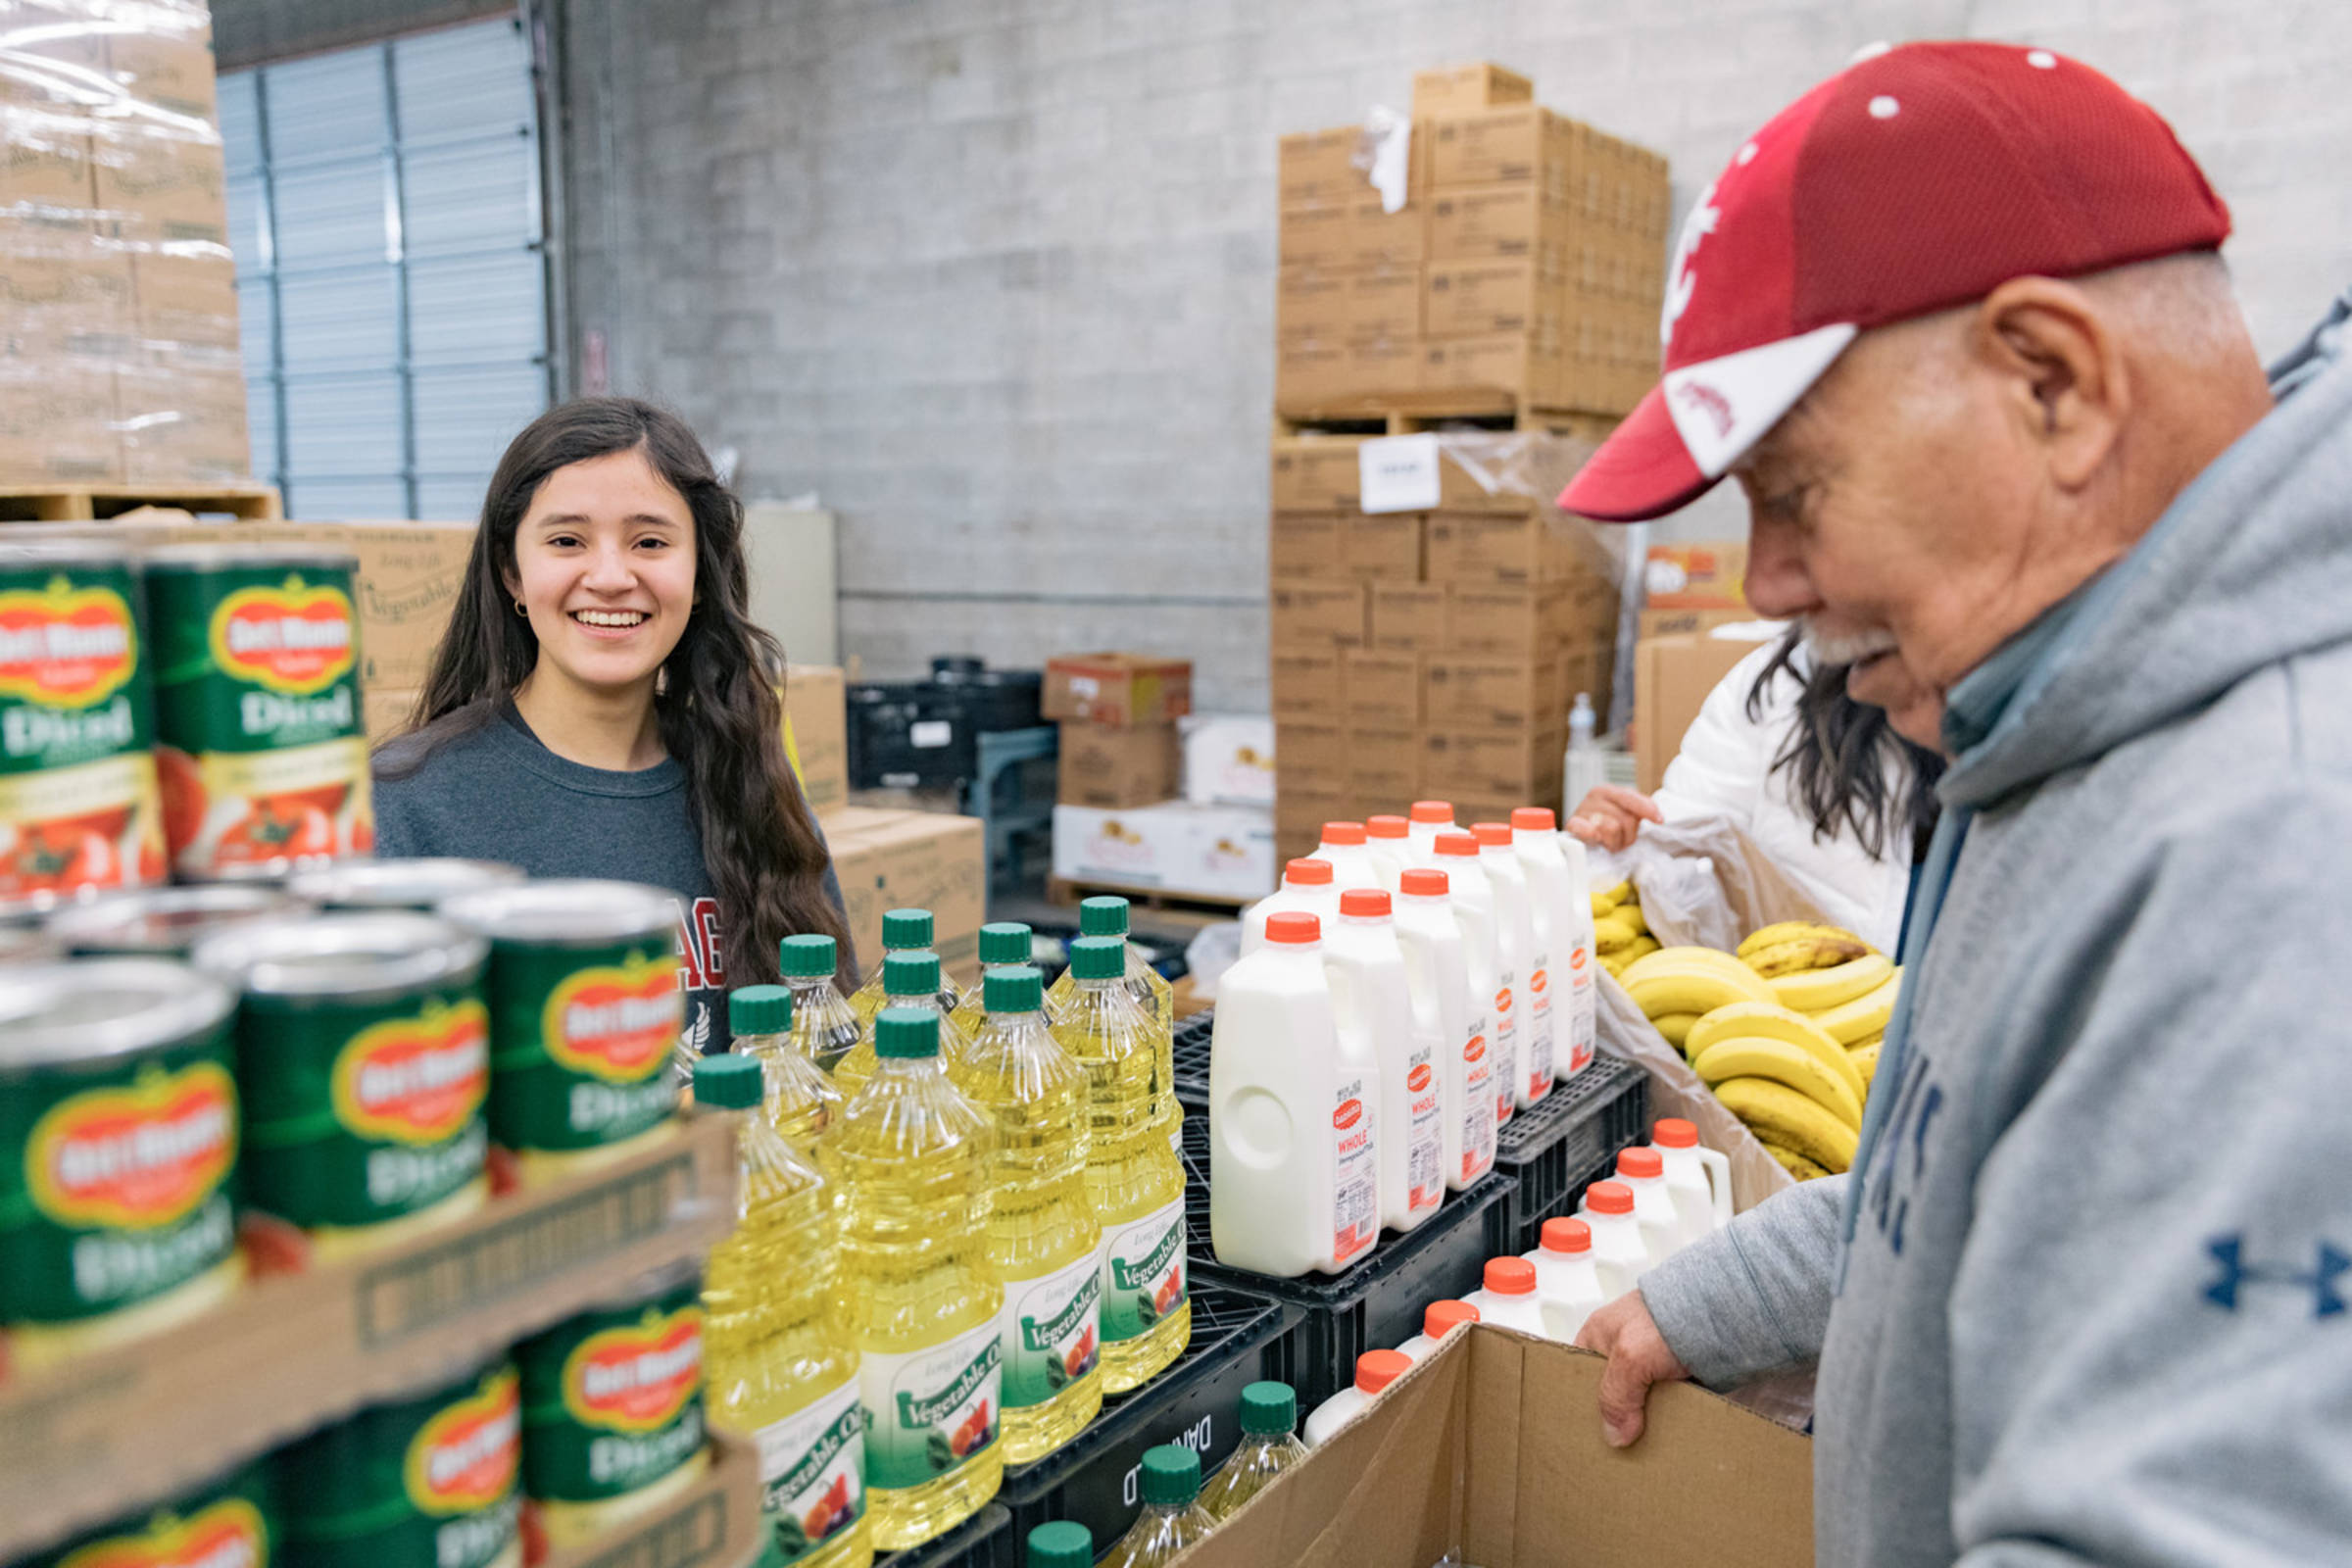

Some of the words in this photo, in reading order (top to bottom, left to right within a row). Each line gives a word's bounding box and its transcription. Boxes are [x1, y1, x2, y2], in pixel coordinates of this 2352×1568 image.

[1412, 1093, 1436, 1115] WHOLE
[1338, 1129, 1367, 1154] WHOLE
[1122, 1235, 1176, 1286] Vegetable
[1030, 1292, 1092, 1347] Vegetable
[907, 1363, 986, 1425] Vegetable
[763, 1434, 840, 1509] egetable
